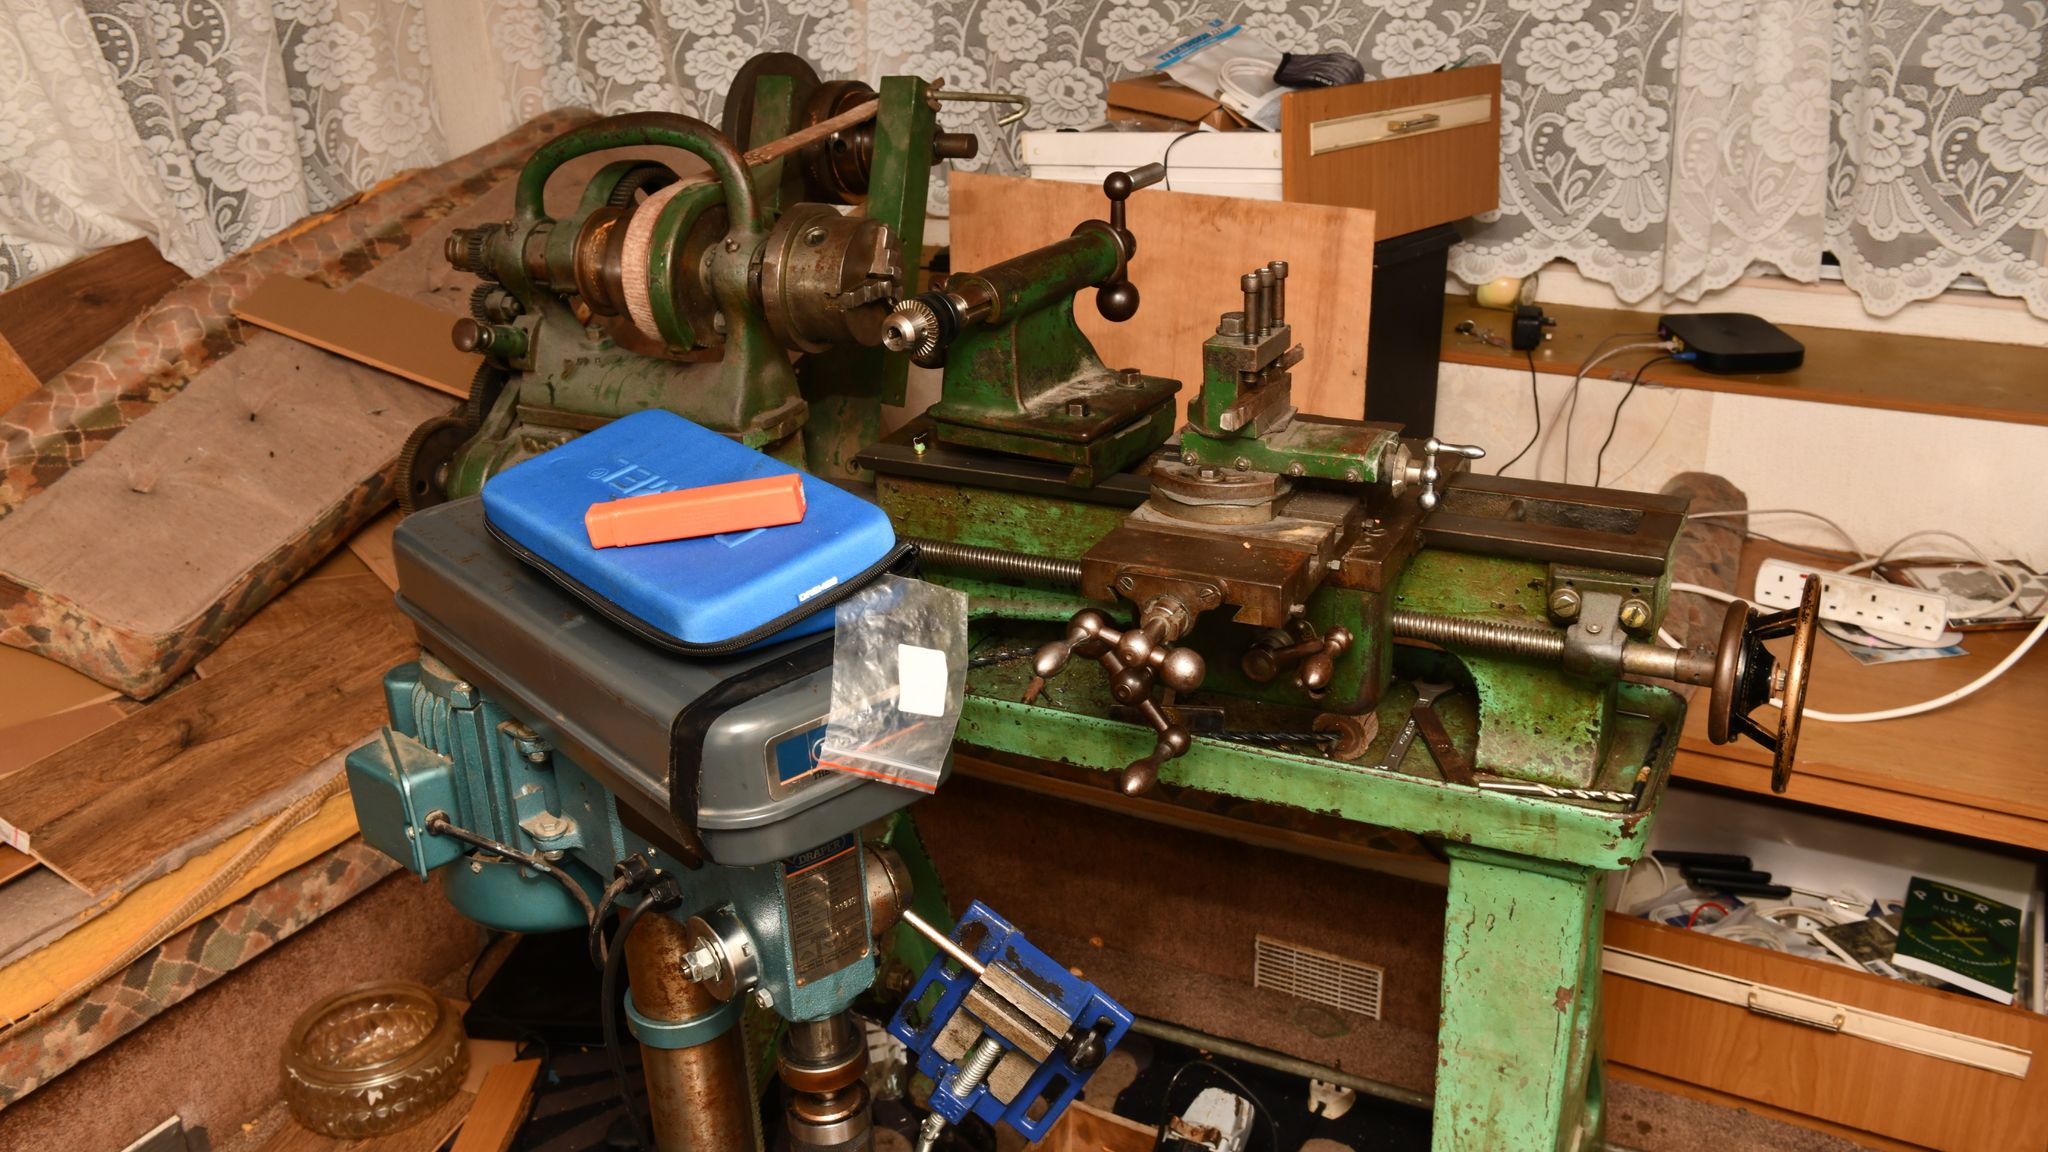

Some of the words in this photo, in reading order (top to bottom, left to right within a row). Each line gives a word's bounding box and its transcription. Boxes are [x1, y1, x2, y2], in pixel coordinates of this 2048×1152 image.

[798, 839, 841, 864] DRAPER
[1912, 889, 2017, 928] PURE
[1931, 903, 1993, 929] SURVIVAL
